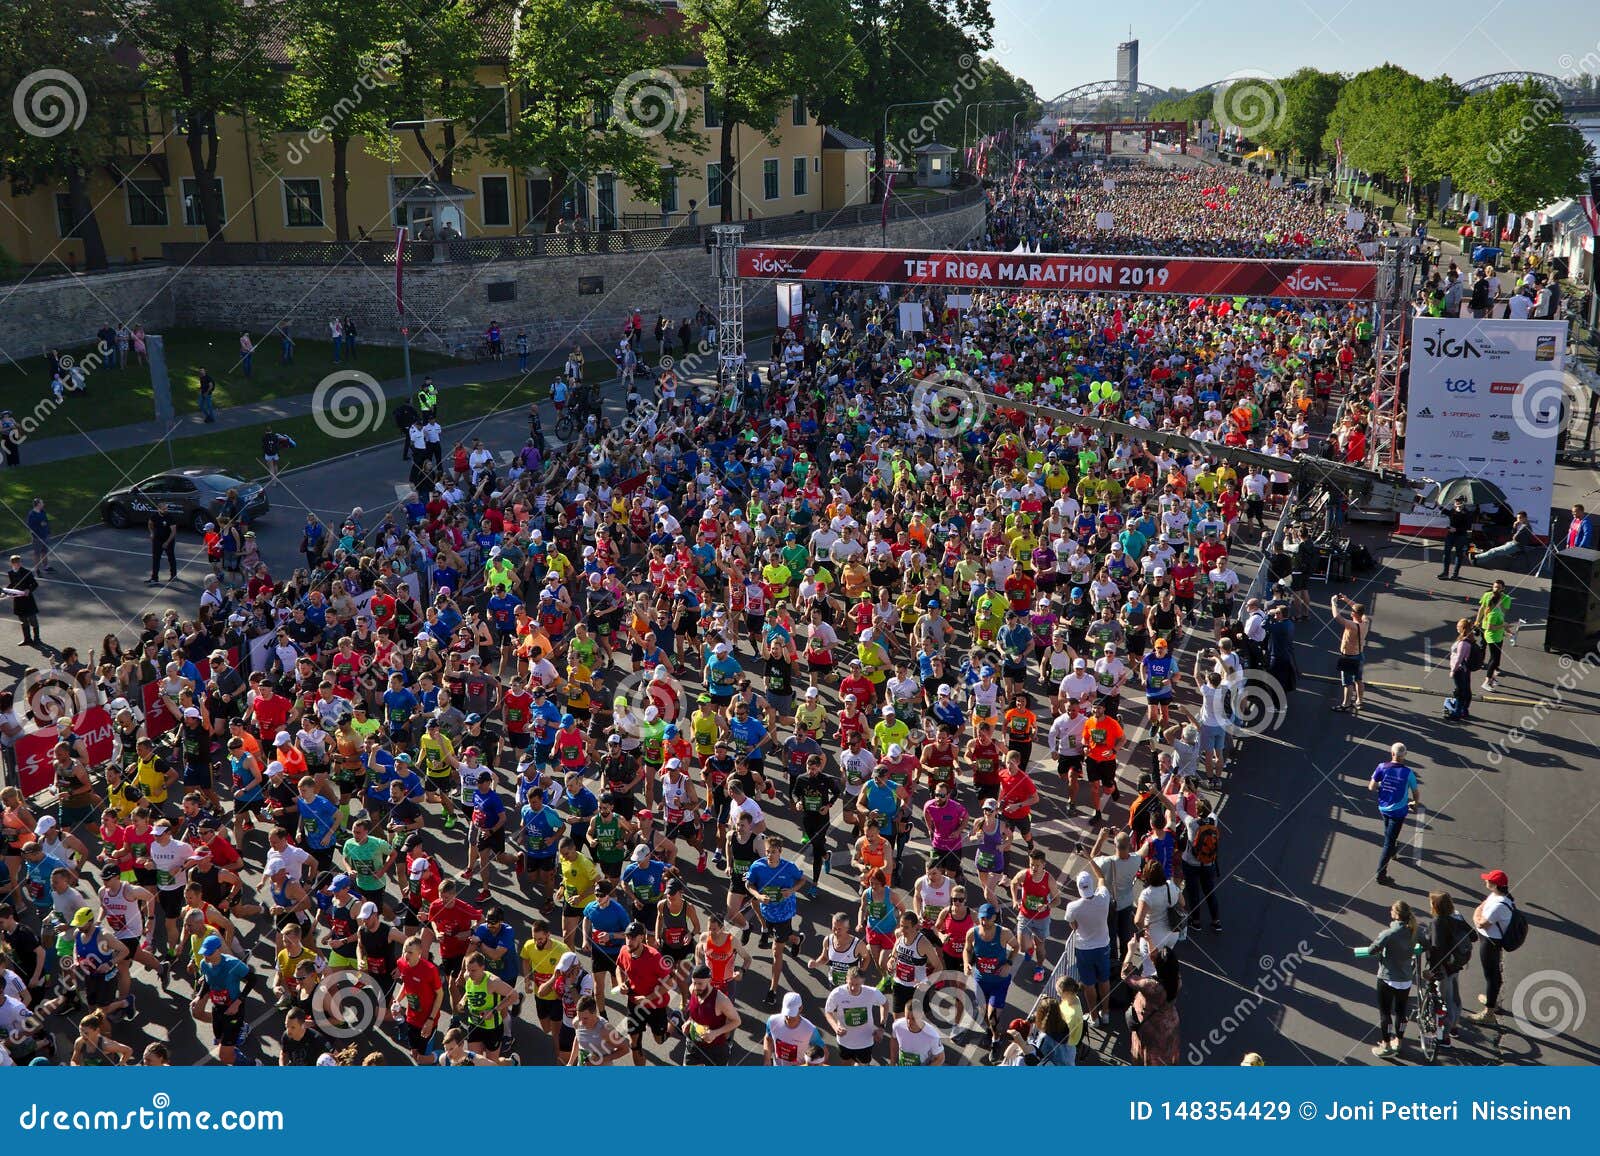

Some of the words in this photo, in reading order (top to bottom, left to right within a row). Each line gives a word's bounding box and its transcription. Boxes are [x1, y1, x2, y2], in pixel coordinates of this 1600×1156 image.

[904, 260, 940, 278] TET
[946, 261, 991, 280] RIGA
[998, 263, 1113, 284] MARATHON
[1119, 267, 1169, 286] 2019
[1445, 377, 1477, 394] tet
